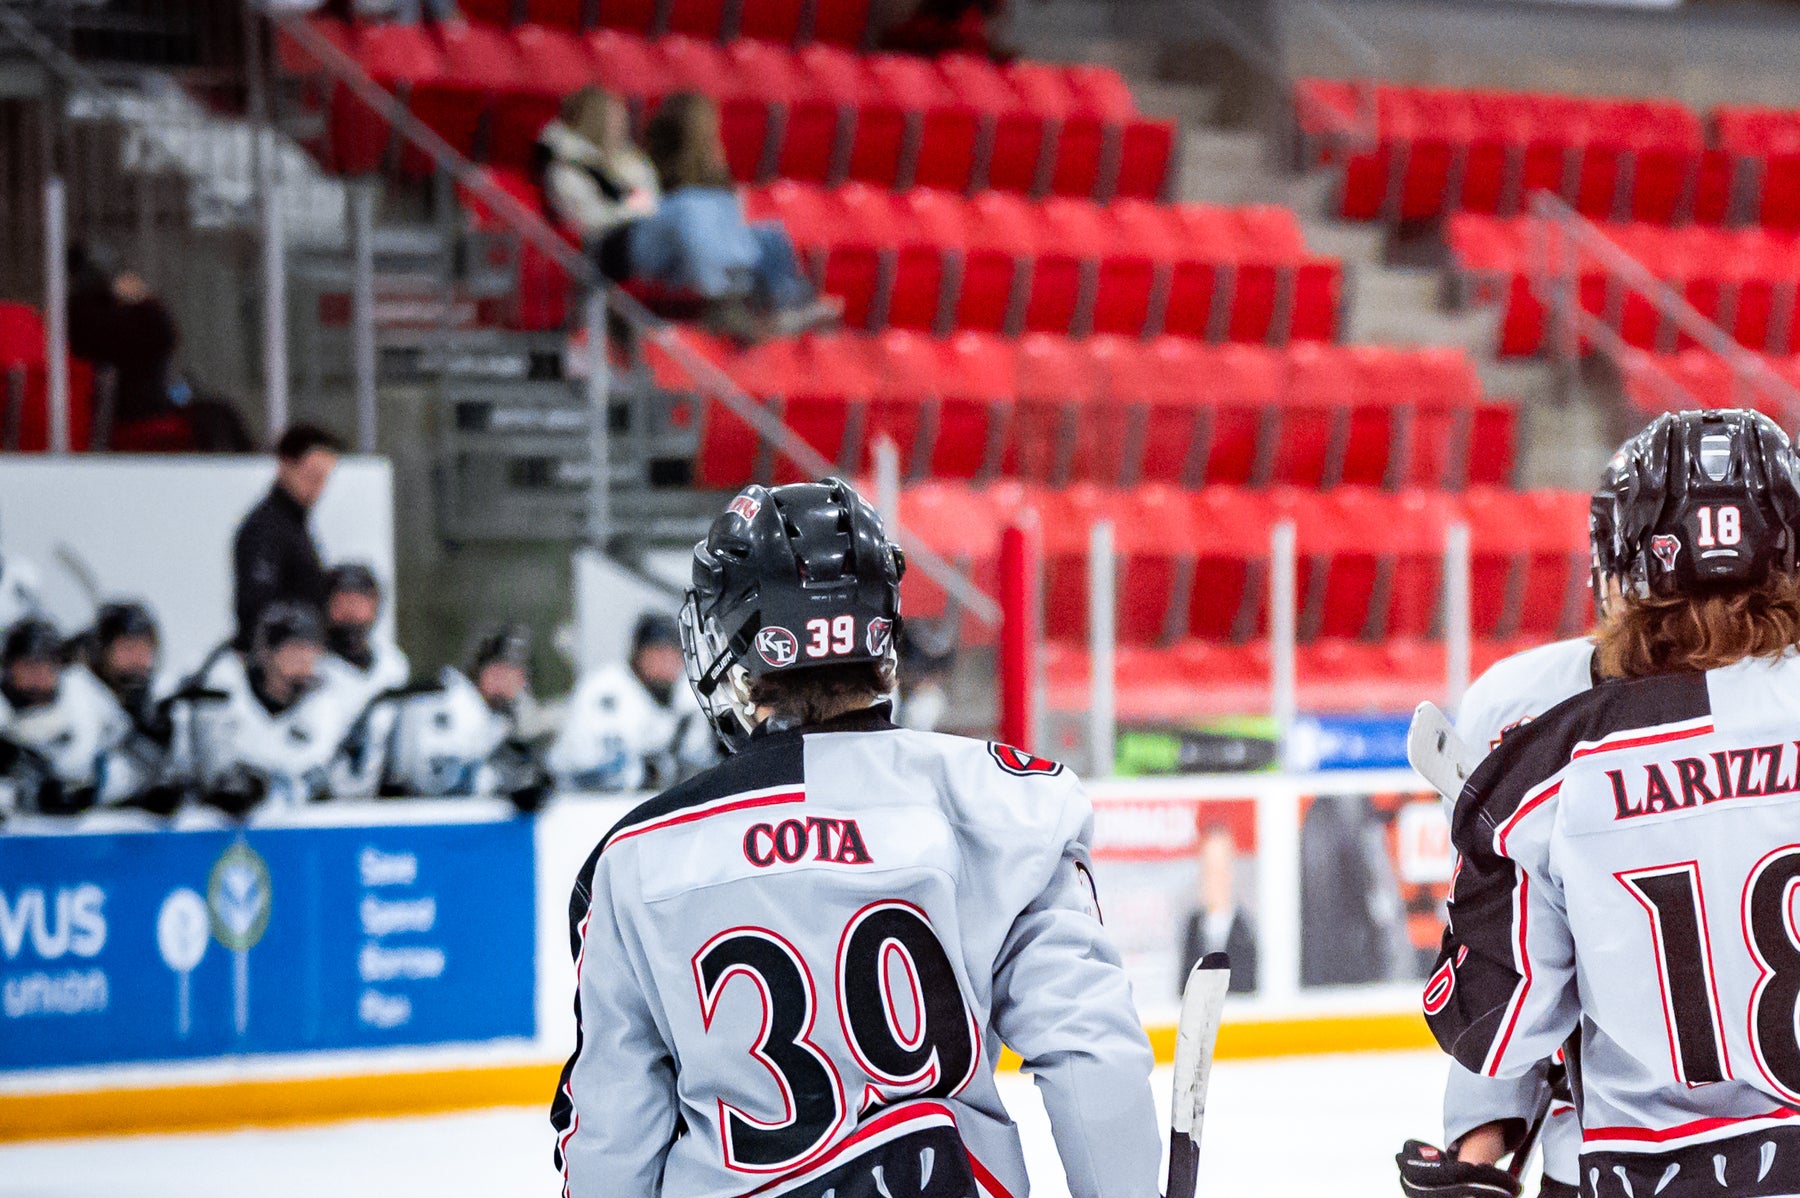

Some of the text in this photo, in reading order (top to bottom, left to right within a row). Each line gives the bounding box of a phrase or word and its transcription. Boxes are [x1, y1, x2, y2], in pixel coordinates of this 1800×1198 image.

[1697, 506, 1741, 547] 18
[806, 615, 854, 657] 39
[743, 816, 874, 868] COTA
[692, 899, 982, 1174] 39
